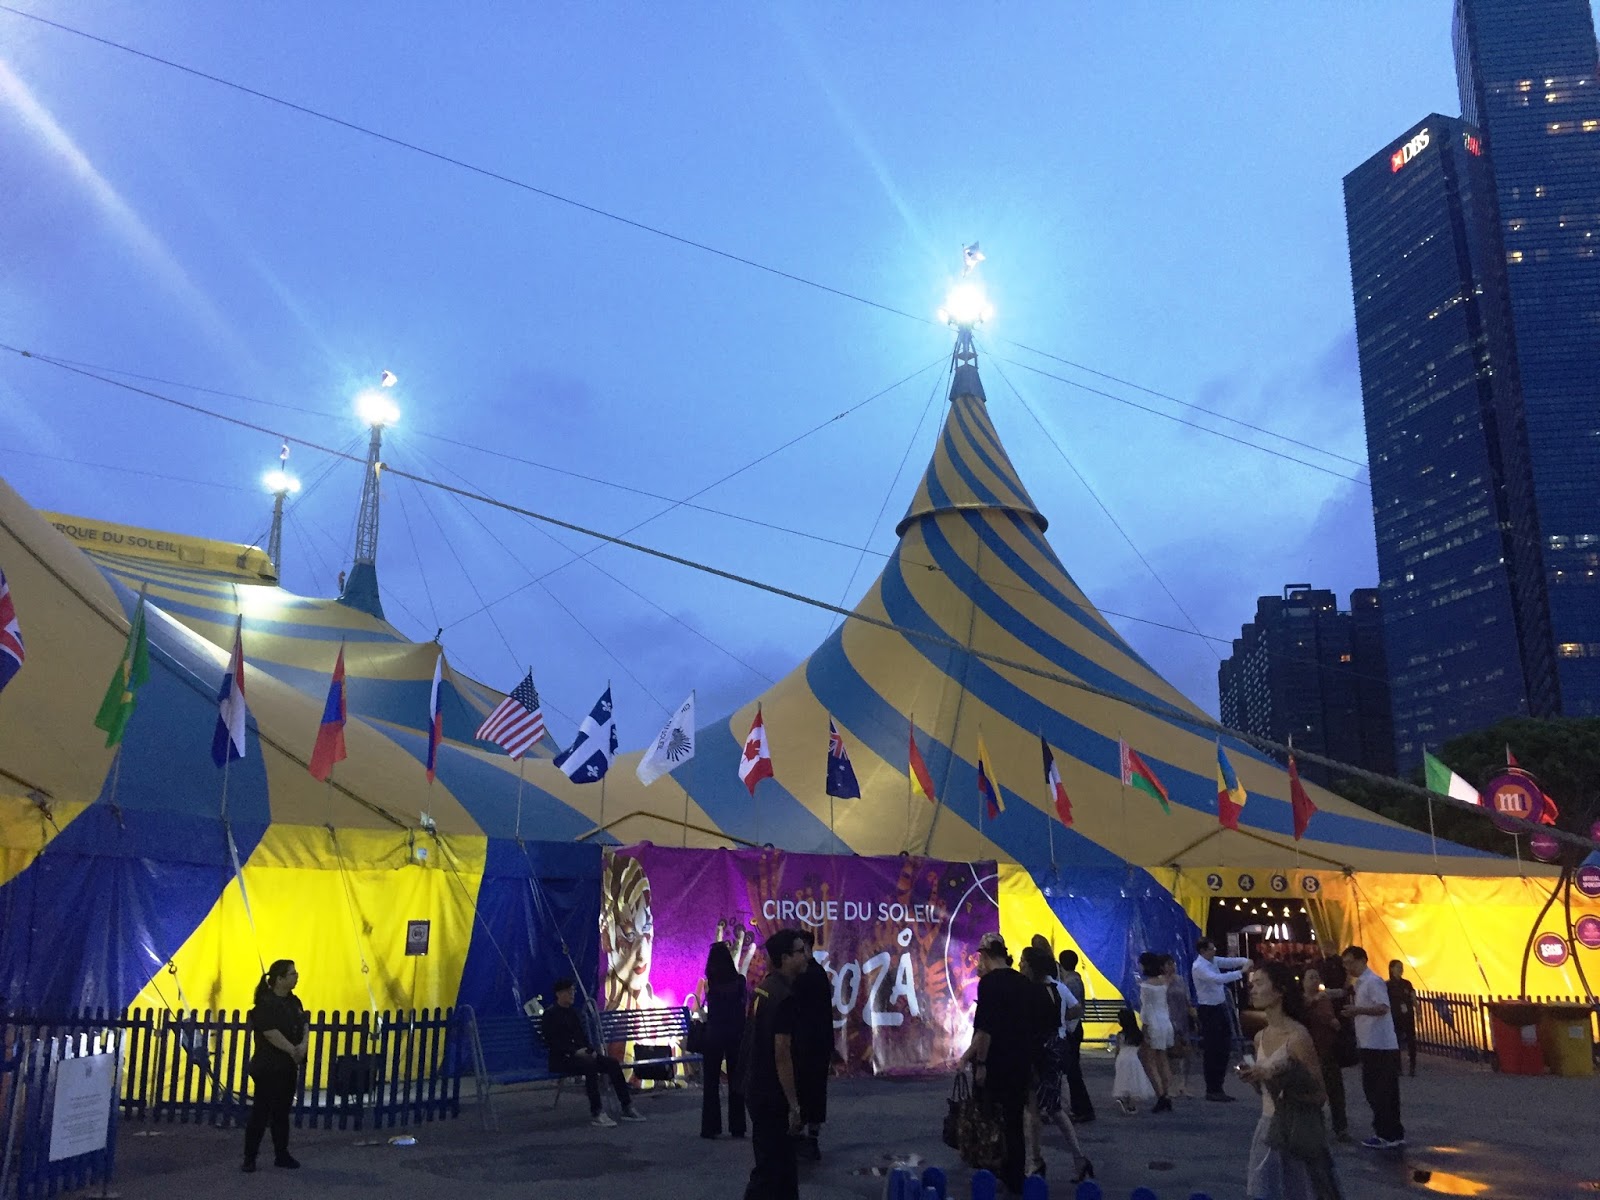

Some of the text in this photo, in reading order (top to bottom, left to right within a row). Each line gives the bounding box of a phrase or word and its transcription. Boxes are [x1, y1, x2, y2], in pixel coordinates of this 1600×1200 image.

[1402, 128, 1430, 164] DBS
[102, 531, 123, 545] DU
[127, 536, 177, 553] SOLEIL
[1210, 874, 1317, 891] 2 4 6 8
[762, 900, 941, 927] CIRQUE DU SOLEIL
